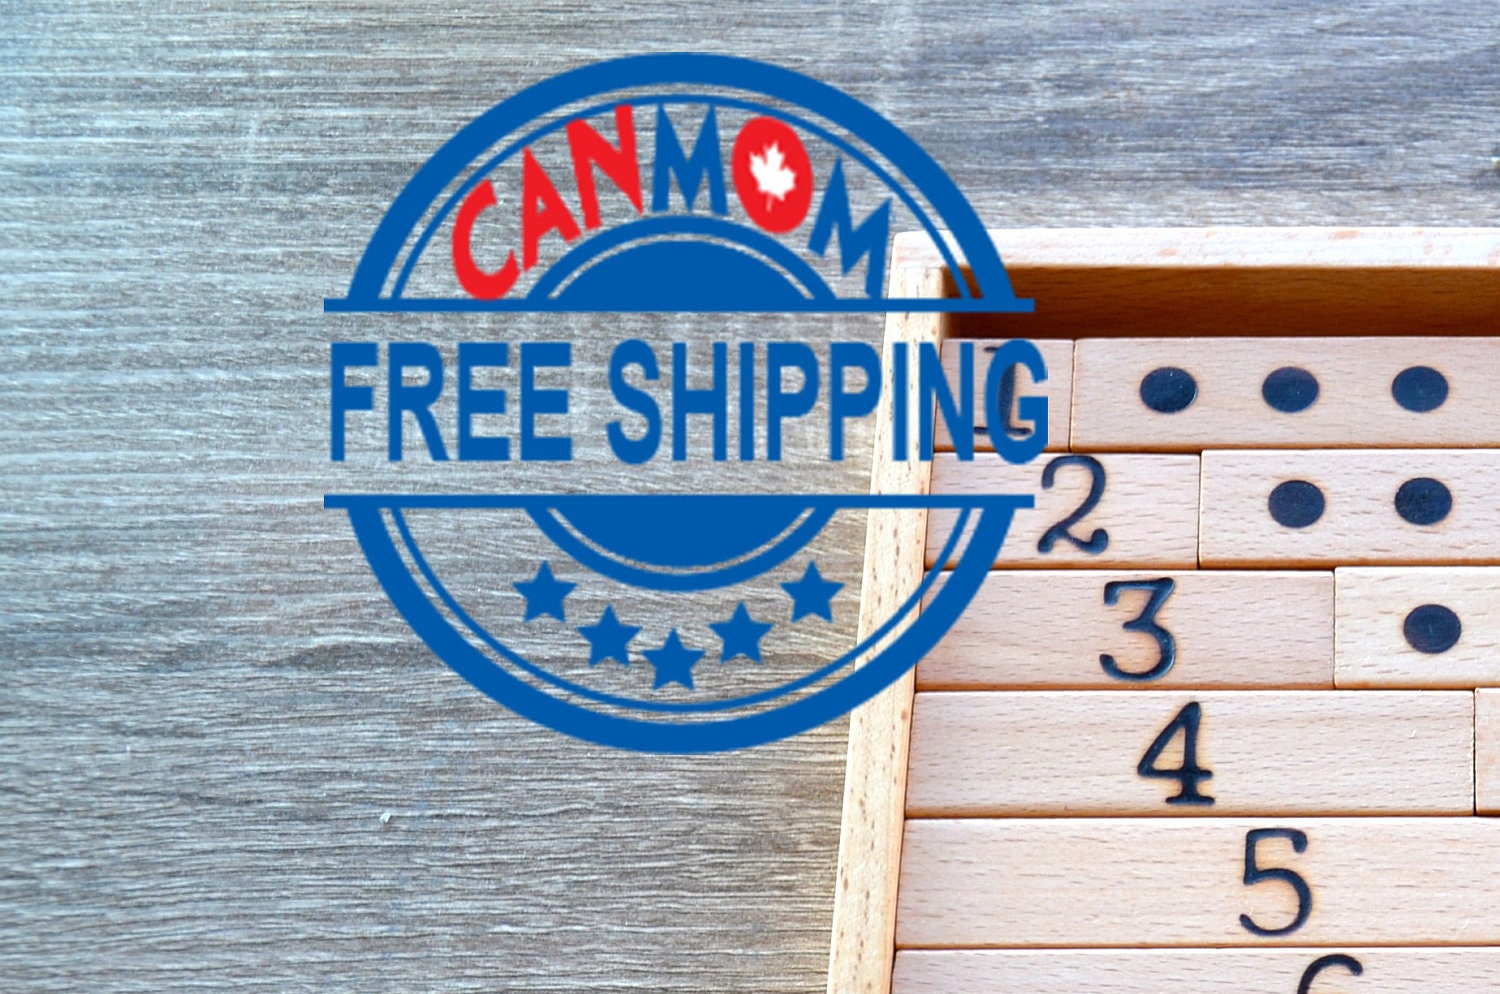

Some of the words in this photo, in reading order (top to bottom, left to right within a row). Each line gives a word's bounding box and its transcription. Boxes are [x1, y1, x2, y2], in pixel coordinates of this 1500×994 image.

[1037, 455, 1109, 554] 2
[1099, 577, 1177, 681] 3
[1137, 701, 1215, 806] 4
[1239, 828, 1312, 937] 5
